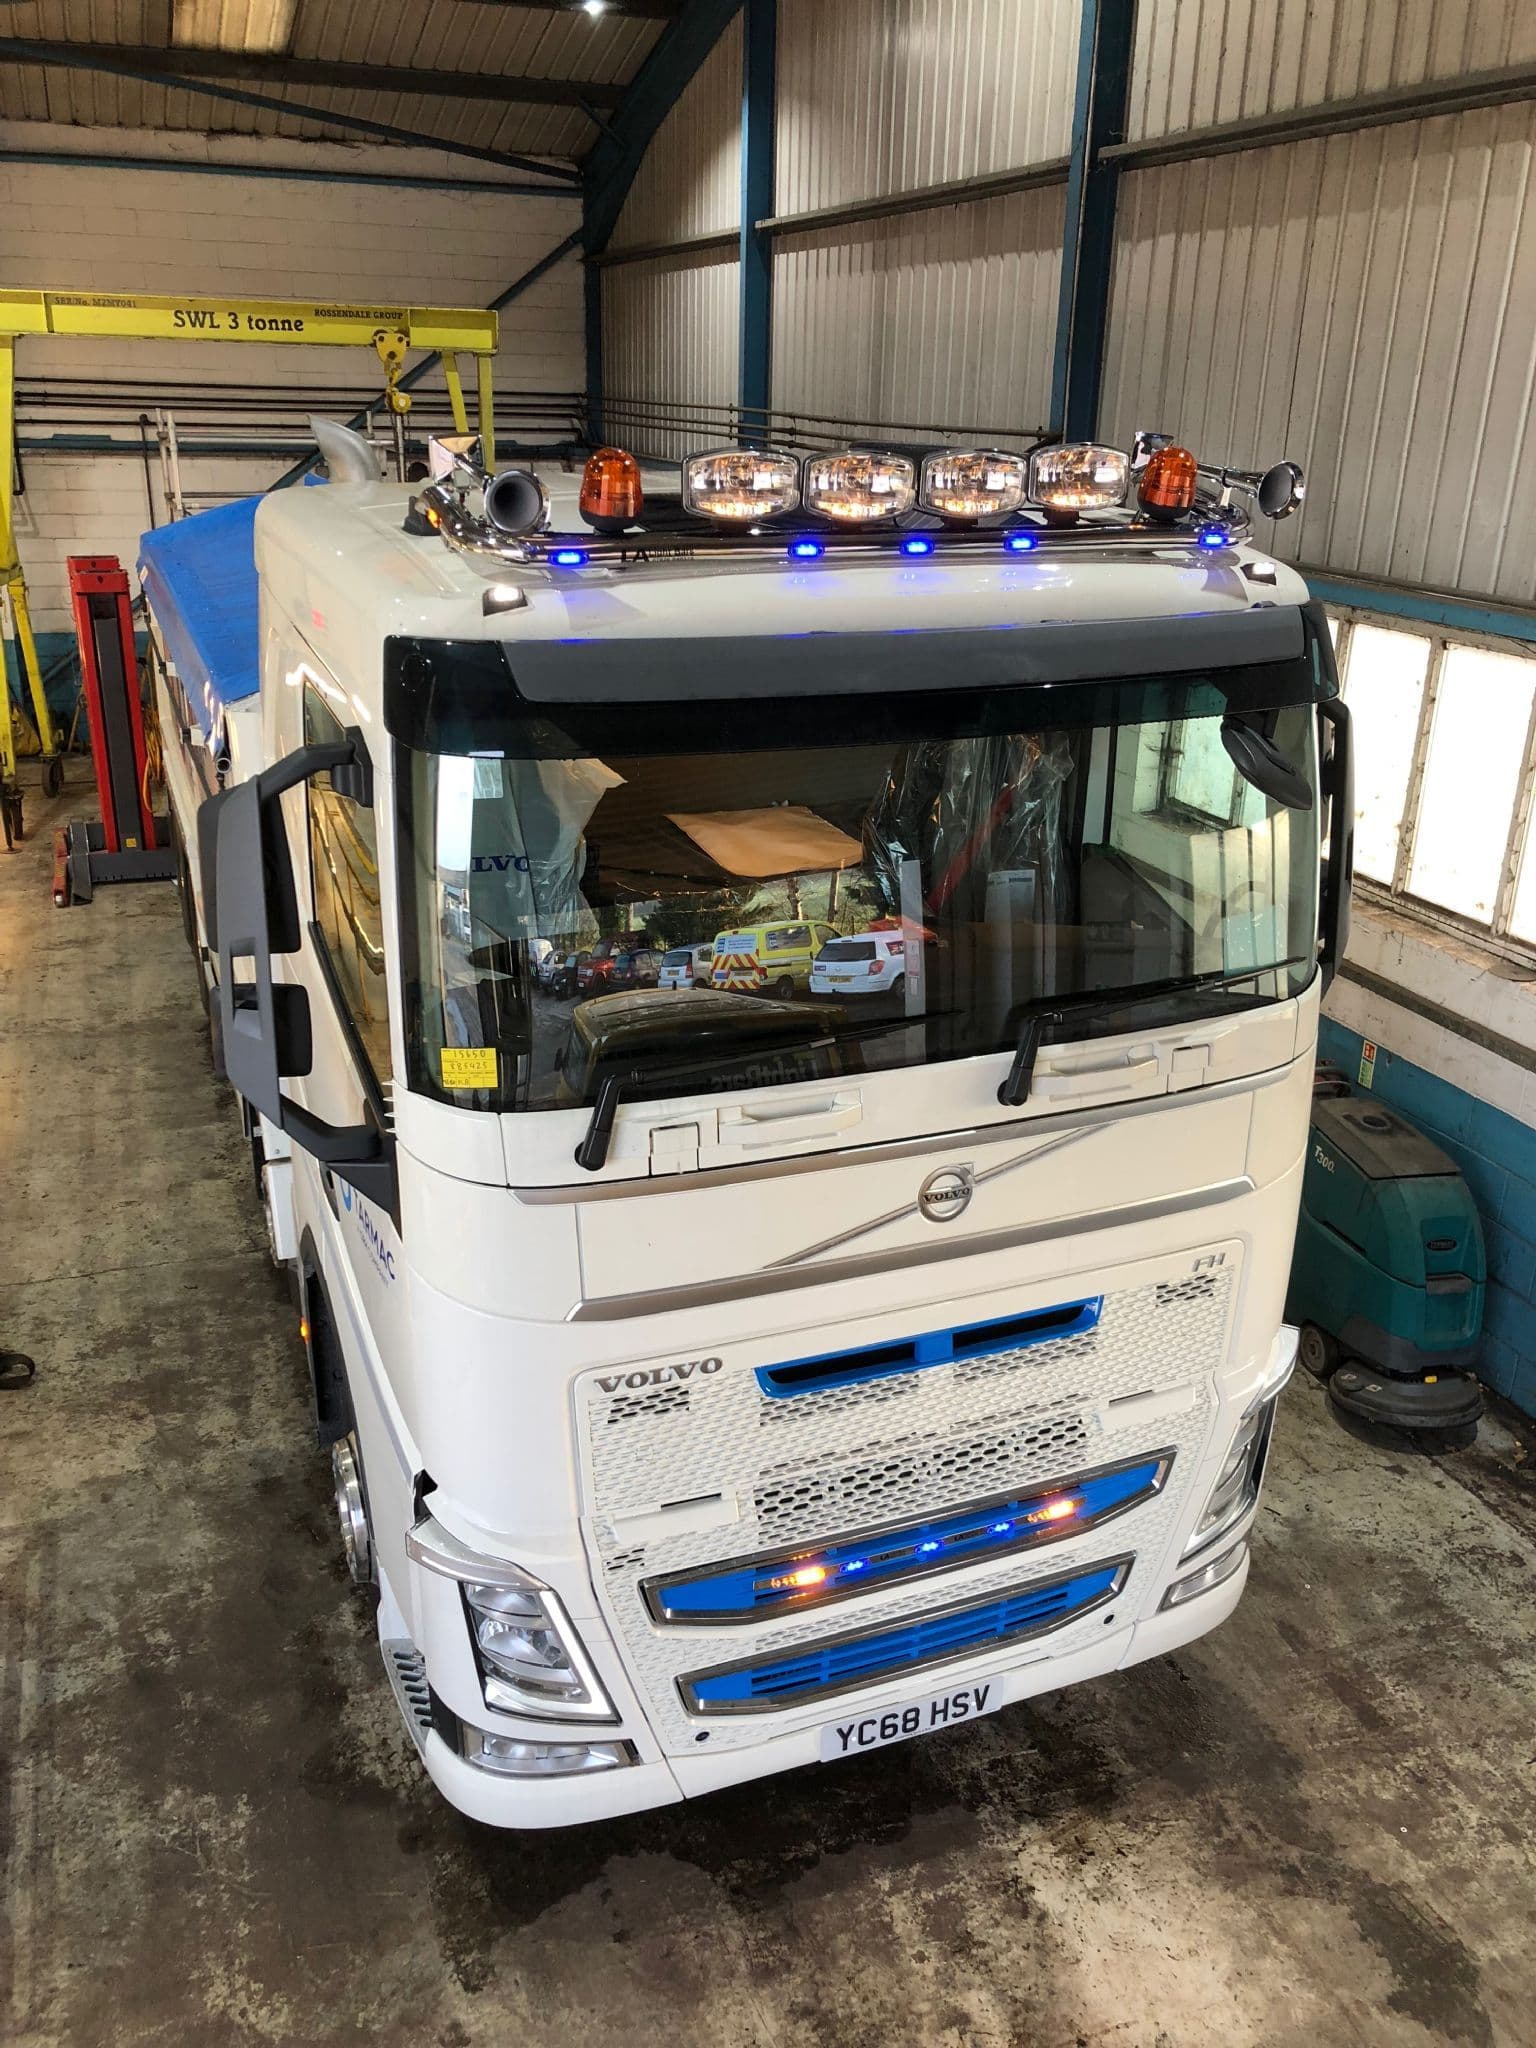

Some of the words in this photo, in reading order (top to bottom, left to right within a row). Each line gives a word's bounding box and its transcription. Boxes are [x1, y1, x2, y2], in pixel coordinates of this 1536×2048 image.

[173, 309, 220, 329] SWL
[228, 311, 239, 330] 3
[247, 314, 304, 332] tonne
[314, 308, 371, 318] ROSSENDALE
[373, 310, 404, 320] GROUP
[471, 854, 530, 873] LVO
[923, 1187, 970, 1202] VOLVO
[593, 1357, 723, 1393] VOLVO
[836, 1706, 921, 1751] YC68
[930, 1684, 991, 1726] HSV
